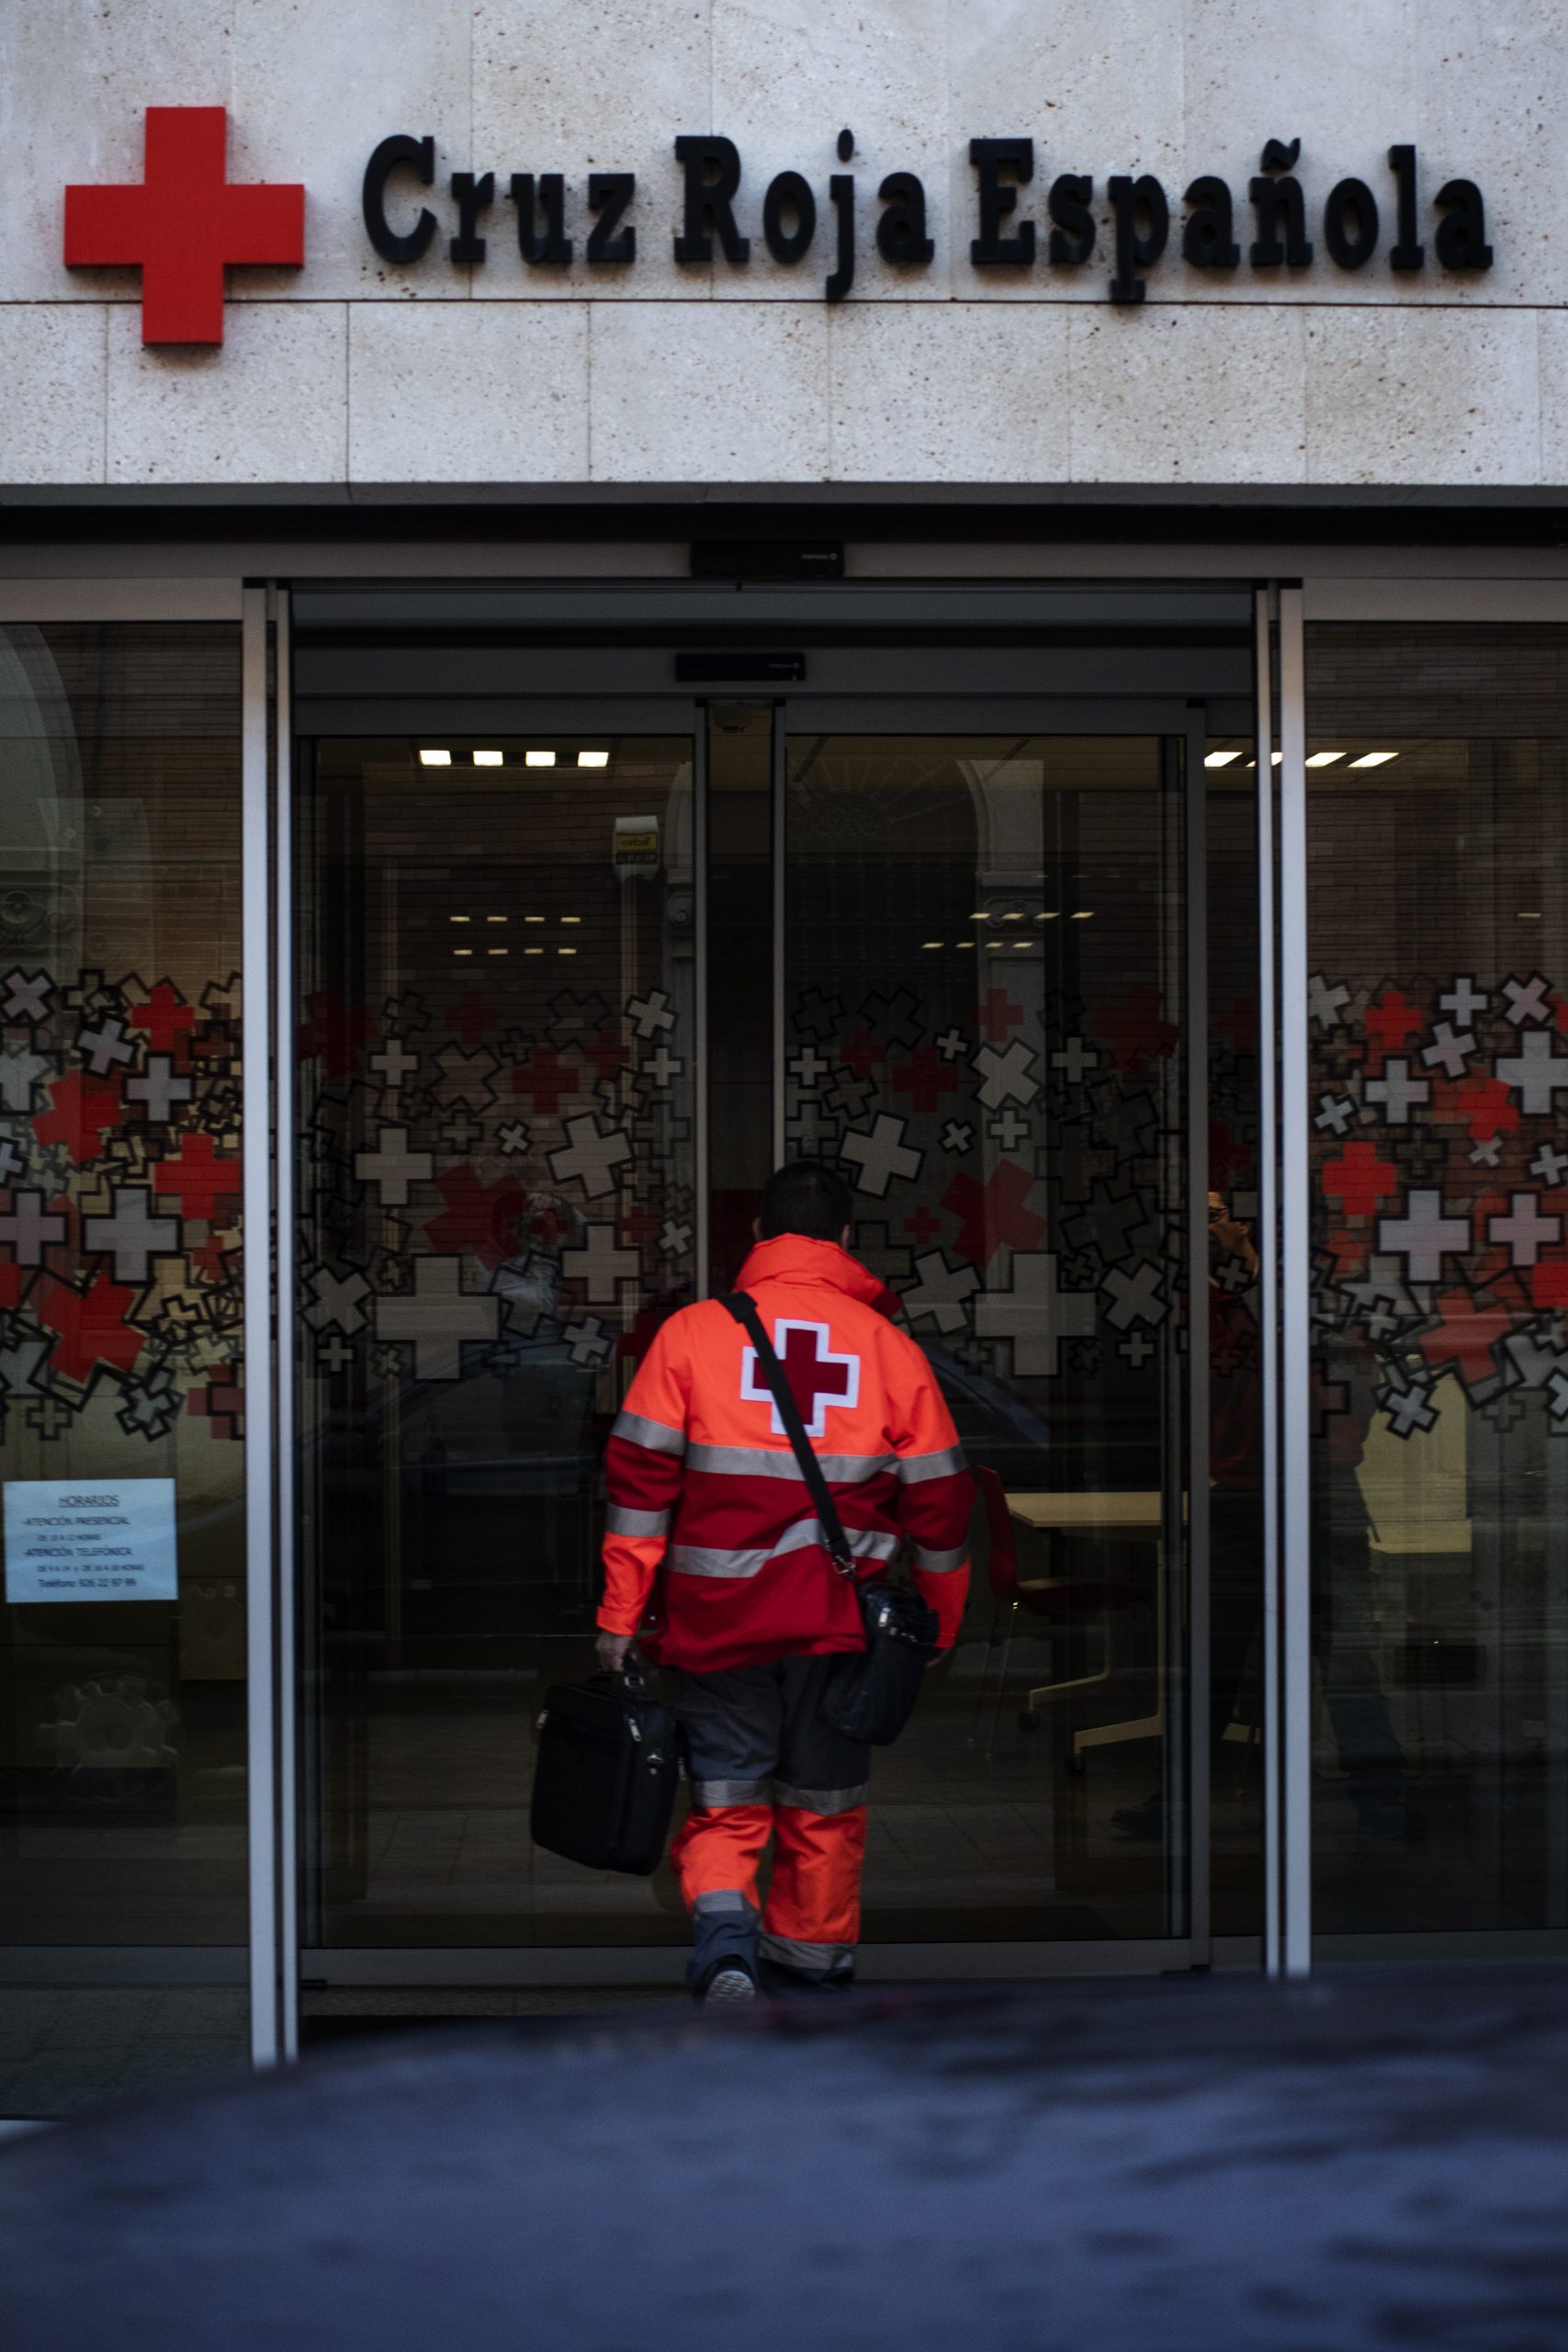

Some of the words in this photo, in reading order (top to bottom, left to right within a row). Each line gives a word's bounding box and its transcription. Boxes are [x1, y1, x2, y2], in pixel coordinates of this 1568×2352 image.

[362, 134, 635, 266] Cruz
[673, 130, 935, 302] Roja
[969, 137, 1495, 304] Española
[59, 1495, 120, 1508] HORARIOS
[75, 1516, 130, 1526] PRESENCIAL
